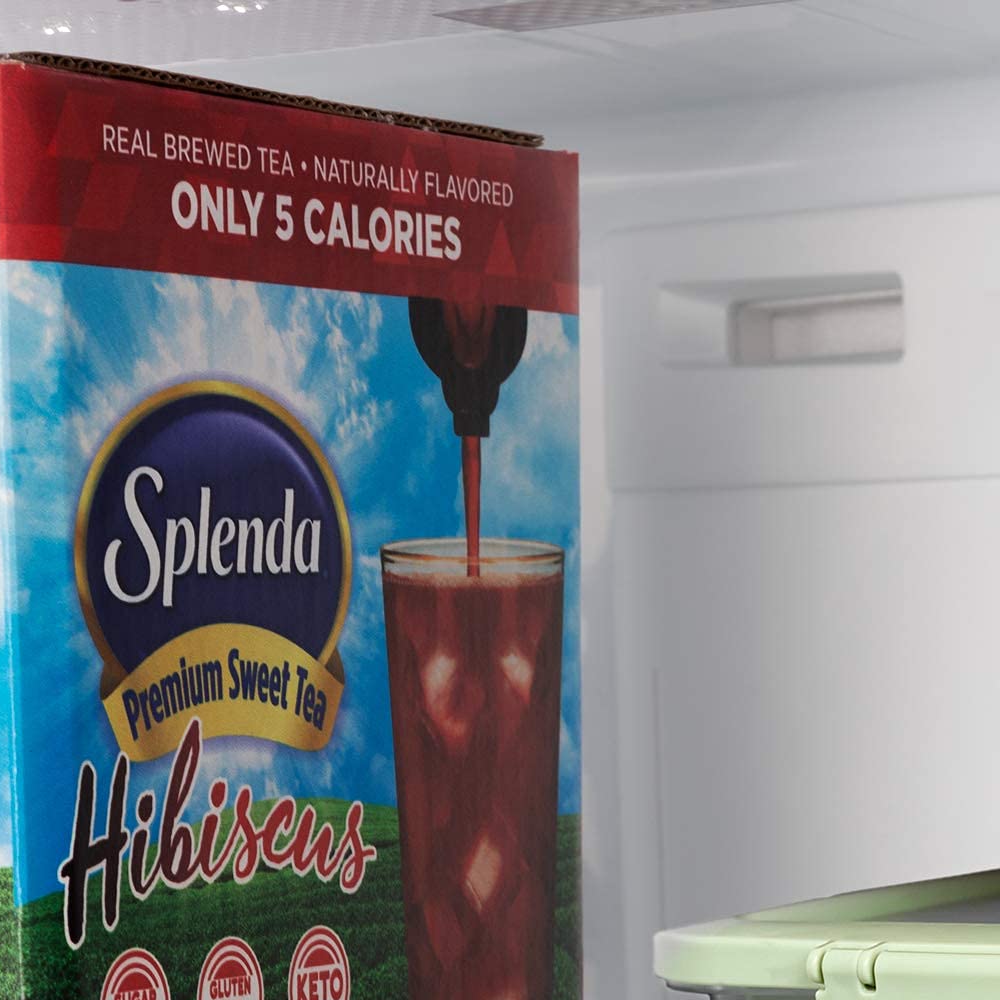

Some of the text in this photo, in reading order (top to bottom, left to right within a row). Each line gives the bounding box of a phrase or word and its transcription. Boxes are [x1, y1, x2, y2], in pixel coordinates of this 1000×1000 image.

[103, 124, 514, 208] REAL BREWED TEA NATURALLY FLAVORED
[171, 181, 462, 261] ONLY 5 CALORIES
[104, 466, 321, 607] Splenda
[122, 648, 328, 741] Premium Sweet Tea
[60, 718, 376, 946] Hibiscus
[209, 975, 251, 1000] GLUTEN
